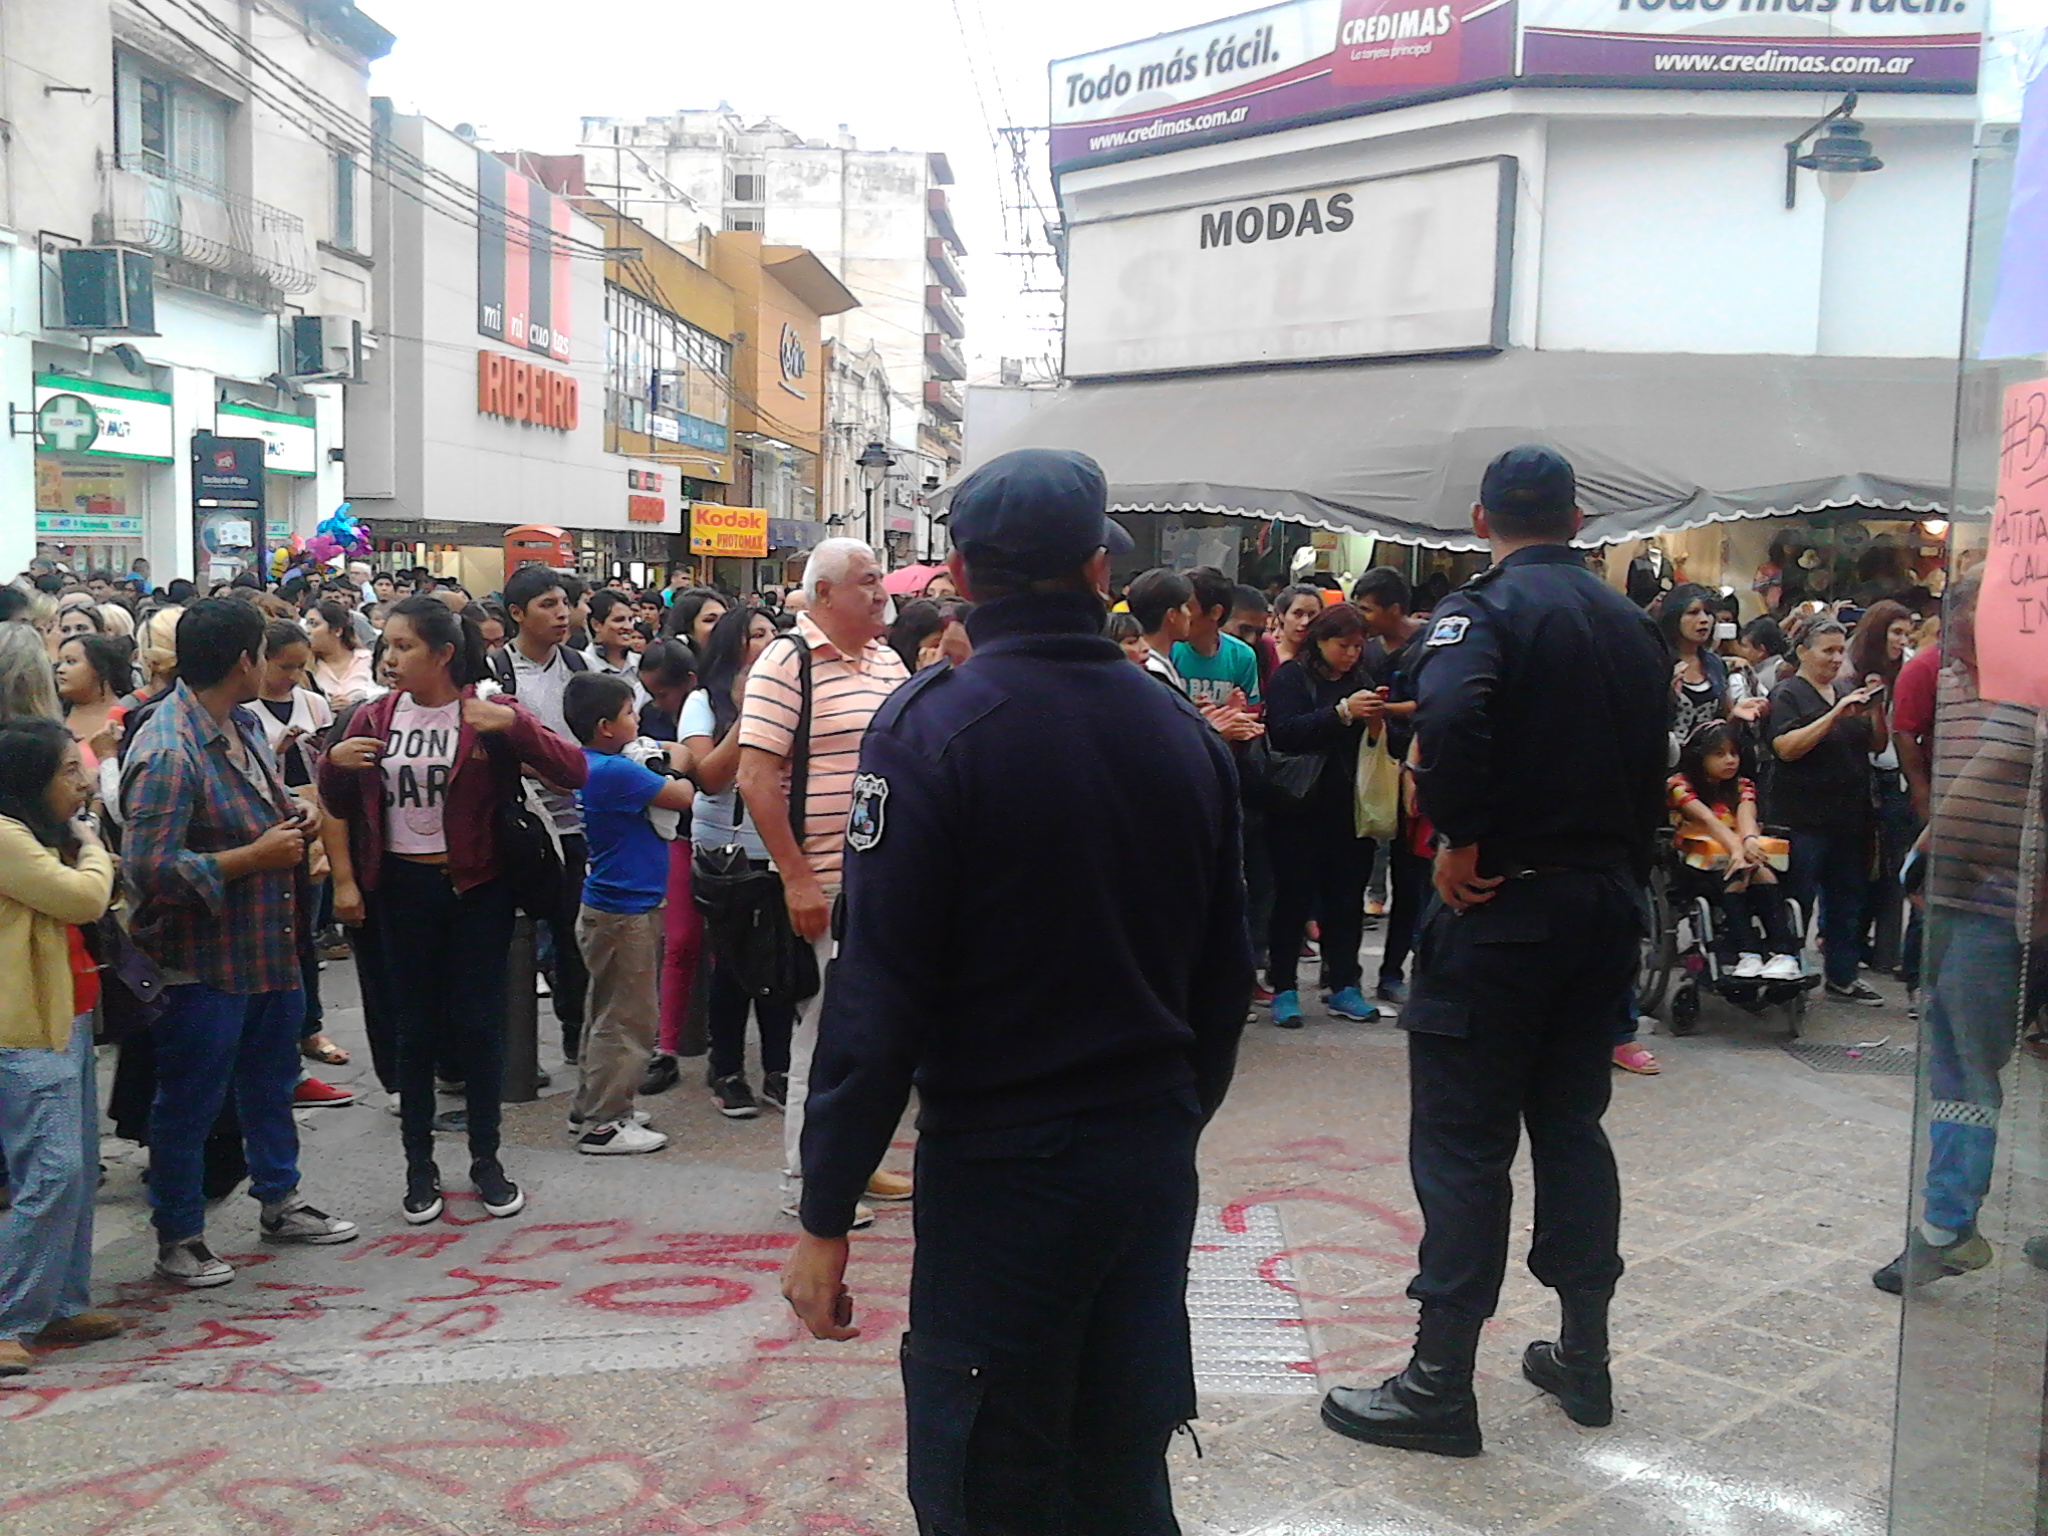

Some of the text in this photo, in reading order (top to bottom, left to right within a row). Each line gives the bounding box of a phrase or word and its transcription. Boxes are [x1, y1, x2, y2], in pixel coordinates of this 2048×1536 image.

[1341, 4, 1451, 46] CREDIMAS
[1066, 25, 1280, 108] Todo más fácil.
[1389, 40, 1433, 60] principal
[1654, 49, 1914, 75] www.credimas.com.ar
[1089, 105, 1250, 151] www.credimas.com.ar
[1200, 193, 1354, 250] MODAS
[483, 303, 501, 331] mi
[511, 312, 523, 339] ni
[552, 328, 569, 355] tas
[478, 350, 578, 430] RIBEIRO
[695, 508, 762, 530] Kodak
[716, 533, 764, 551] PHOTOMAX
[380, 764, 451, 808] AR
